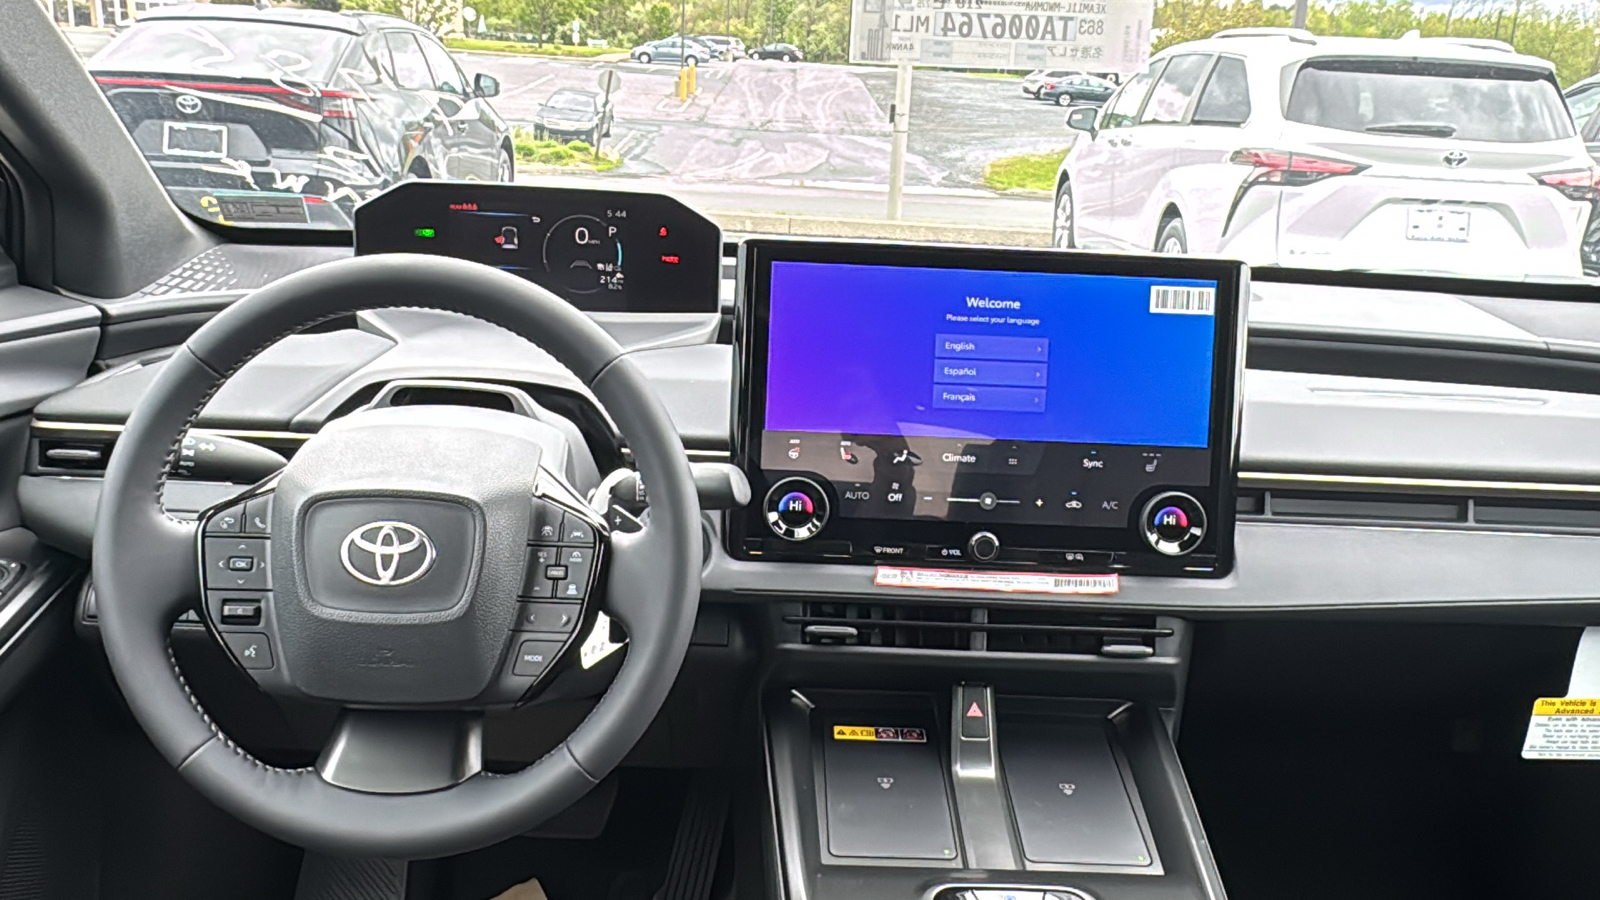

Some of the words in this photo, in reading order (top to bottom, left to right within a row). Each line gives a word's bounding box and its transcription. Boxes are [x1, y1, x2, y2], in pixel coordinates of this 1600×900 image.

[575, 227, 589, 244] 0
[608, 226, 617, 237] P
[966, 296, 1021, 309] Welcome
[946, 313, 968, 322] Please
[969, 315, 989, 323] select
[991, 317, 1005, 325] your
[1006, 316, 1040, 326] language
[945, 342, 975, 352] English
[944, 367, 977, 376] Español
[942, 392, 976, 403] Français
[942, 453, 976, 463] Climate
[1082, 458, 1104, 469] Sync
[844, 491, 870, 500] AUTO
[887, 493, 903, 503] Off
[789, 500, 803, 511] Hi
[1101, 500, 1119, 510] A/C
[1163, 514, 1177, 525] Hi
[523, 653, 543, 662] MODE
